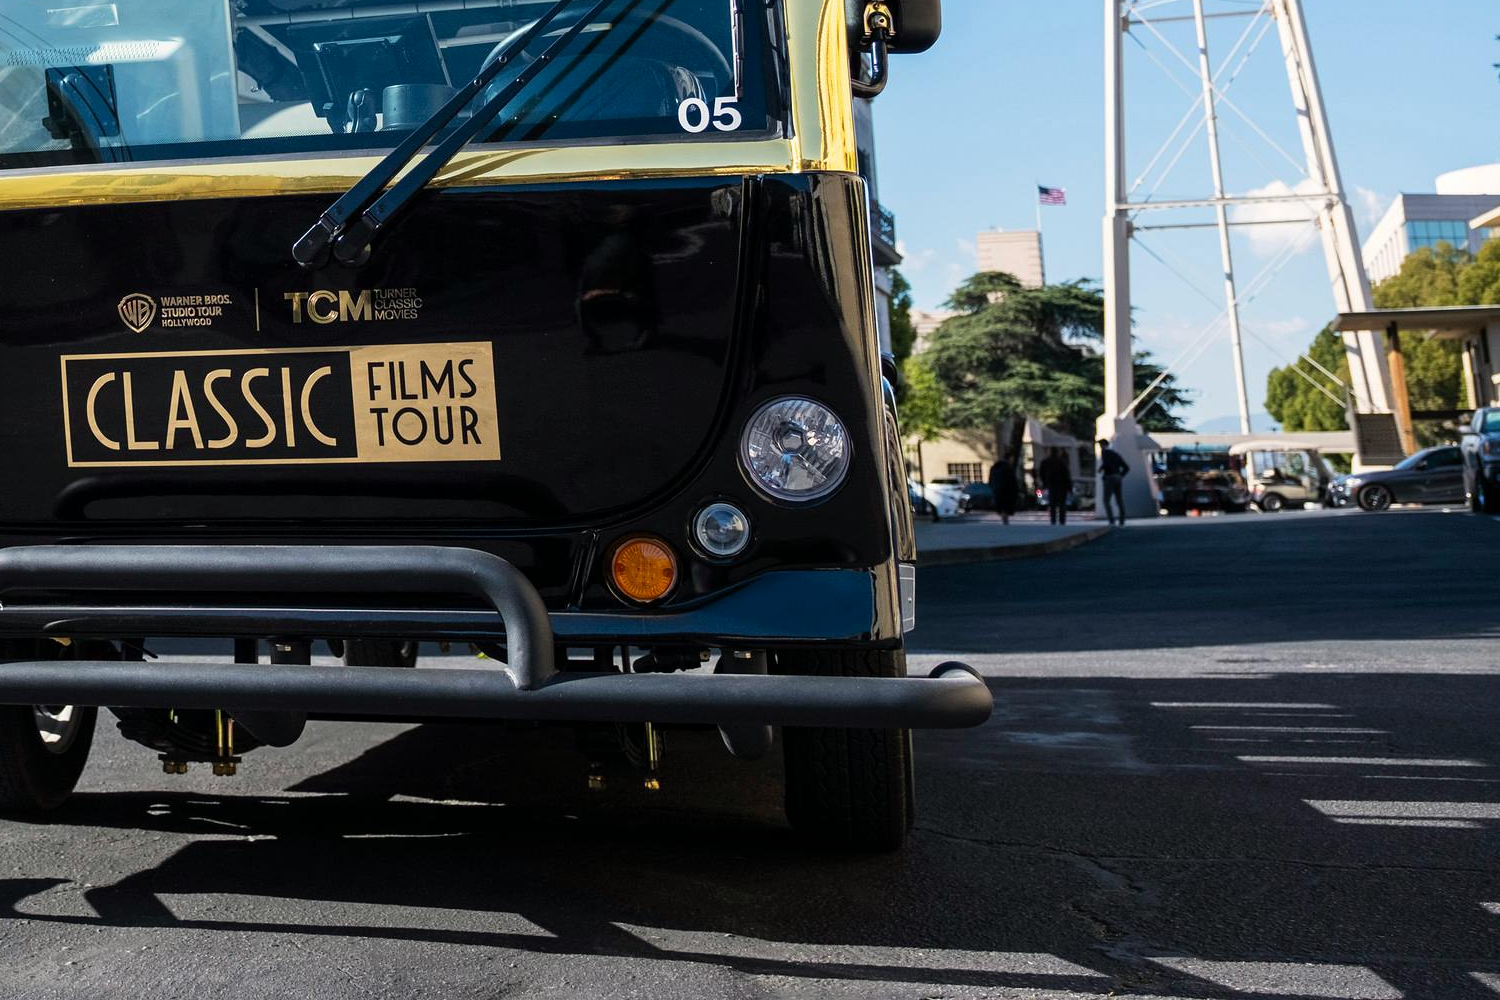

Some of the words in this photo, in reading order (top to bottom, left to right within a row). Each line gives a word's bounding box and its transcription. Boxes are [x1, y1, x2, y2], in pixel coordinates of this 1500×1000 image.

[678, 96, 742, 133] 05
[374, 288, 417, 299] TURNER
[160, 295, 203, 307] WARNER
[204, 294, 233, 306] BROS.
[284, 289, 373, 325] TCM
[374, 298, 423, 310] CLASSIC
[161, 307, 196, 318] STUDIO
[198, 306, 223, 317] TOUR
[375, 308, 418, 321] MOVIES
[161, 318, 212, 328] HOLLYWOOD
[367, 358, 477, 401] FILMS
[86, 366, 337, 451] CLASSIC
[369, 405, 483, 448] TOUR
